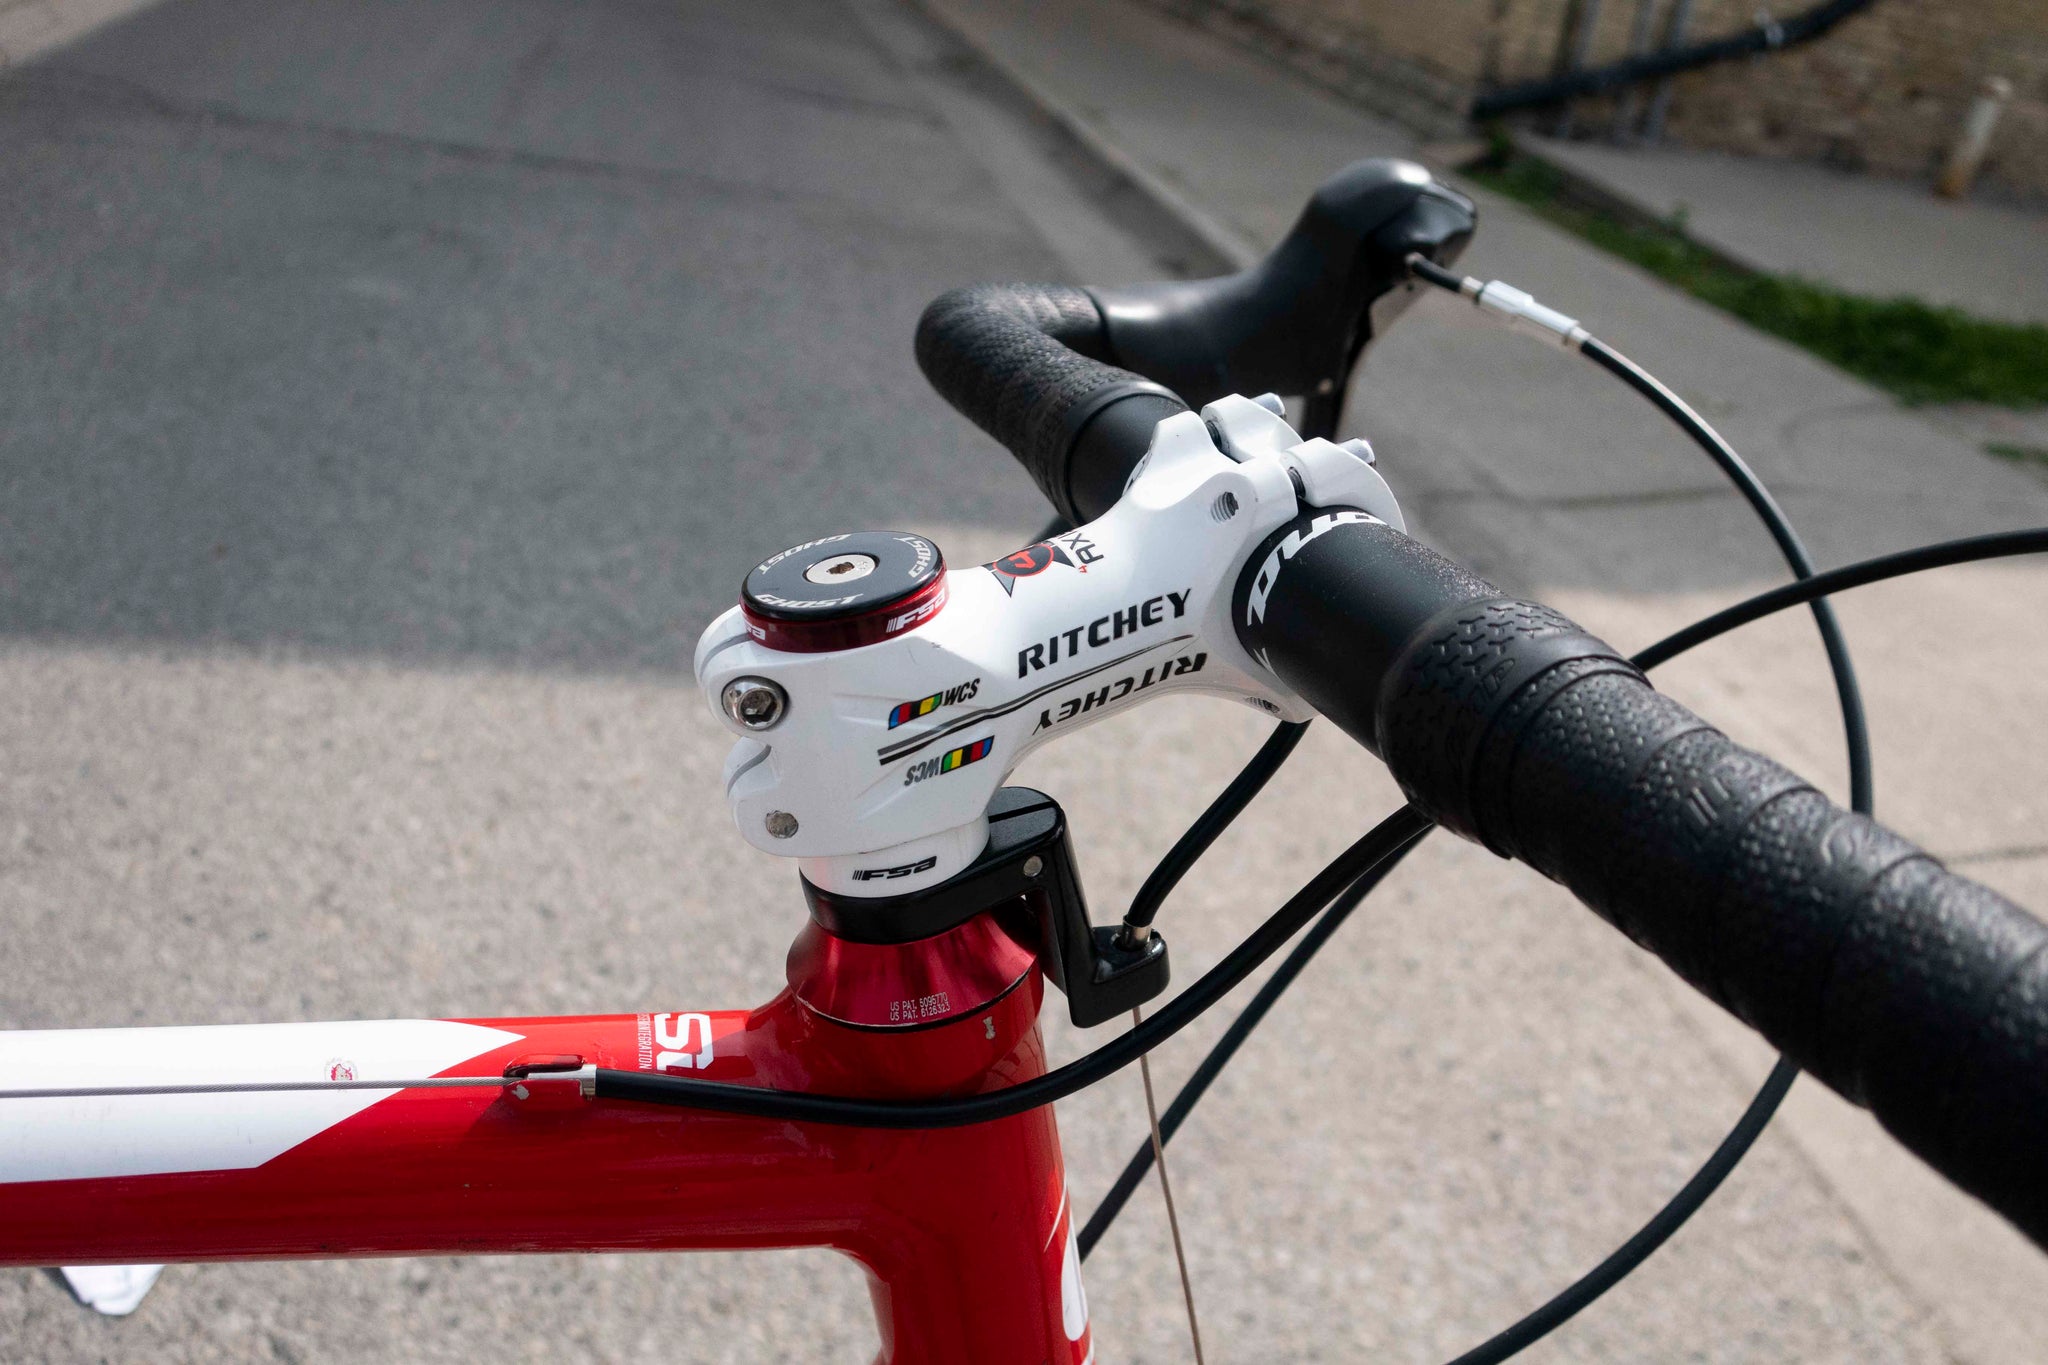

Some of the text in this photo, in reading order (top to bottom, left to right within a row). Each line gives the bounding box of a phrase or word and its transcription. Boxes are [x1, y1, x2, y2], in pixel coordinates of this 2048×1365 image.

[758, 534, 852, 575] GHOST
[892, 537, 931, 578] GHOST
[755, 593, 863, 609] GHOST
[1018, 588, 1192, 680] RITCHEY
[943, 678, 980, 706] WCS
[1032, 652, 1208, 736] RITCHEY
[904, 756, 940, 786] WCS
[890, 1001, 900, 1011] US
[902, 1000, 918, 1011] PAT.
[890, 1011, 900, 1021] US
[902, 1010, 918, 1020] PAT.
